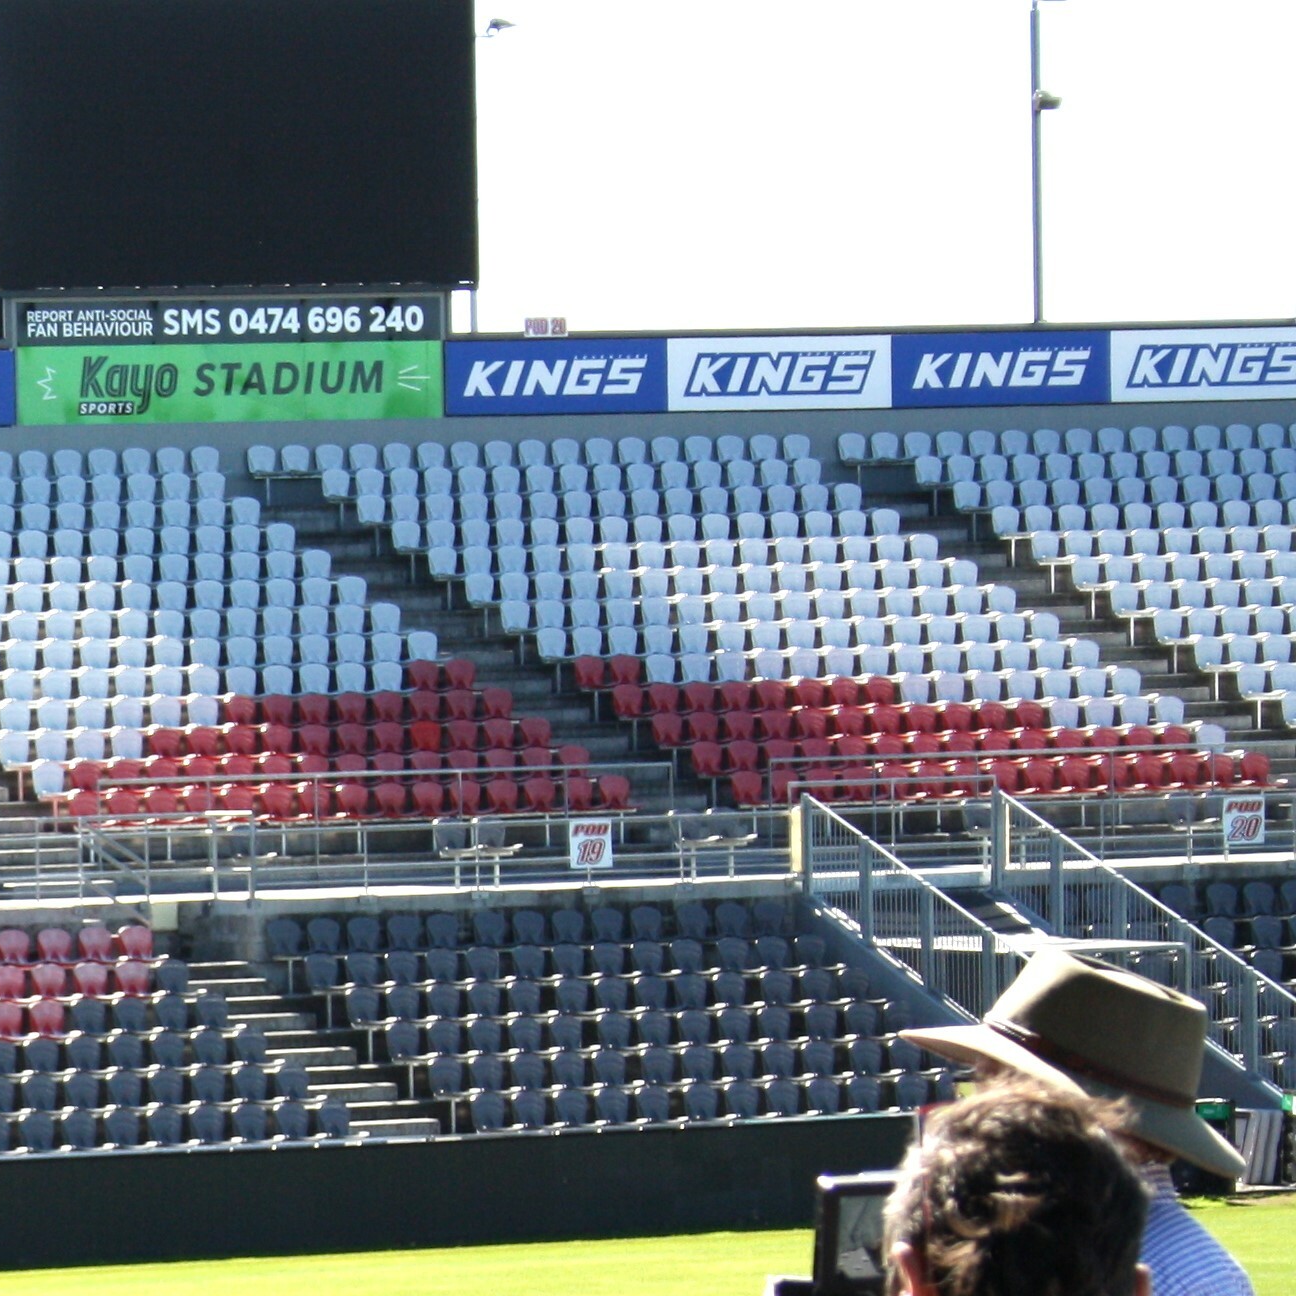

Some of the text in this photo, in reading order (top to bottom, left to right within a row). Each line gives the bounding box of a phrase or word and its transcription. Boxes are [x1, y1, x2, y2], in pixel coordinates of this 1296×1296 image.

[26, 309, 153, 322] REPORT ANTI-SOCIAL
[163, 305, 425, 336] SMS 0474 696 240
[27, 322, 154, 338] FAN BEHAVIOUR
[463, 358, 648, 397] KINGS
[686, 353, 874, 395] KINGS
[912, 350, 1092, 389] KINGS
[1128, 344, 1296, 386] KINGS
[80, 355, 385, 415] Kayo STADIUM
[79, 402, 134, 415] SPORTS
[1225, 800, 1263, 814] POD
[571, 823, 609, 837] POD
[1228, 814, 1262, 841] 20
[576, 838, 606, 866] 19
